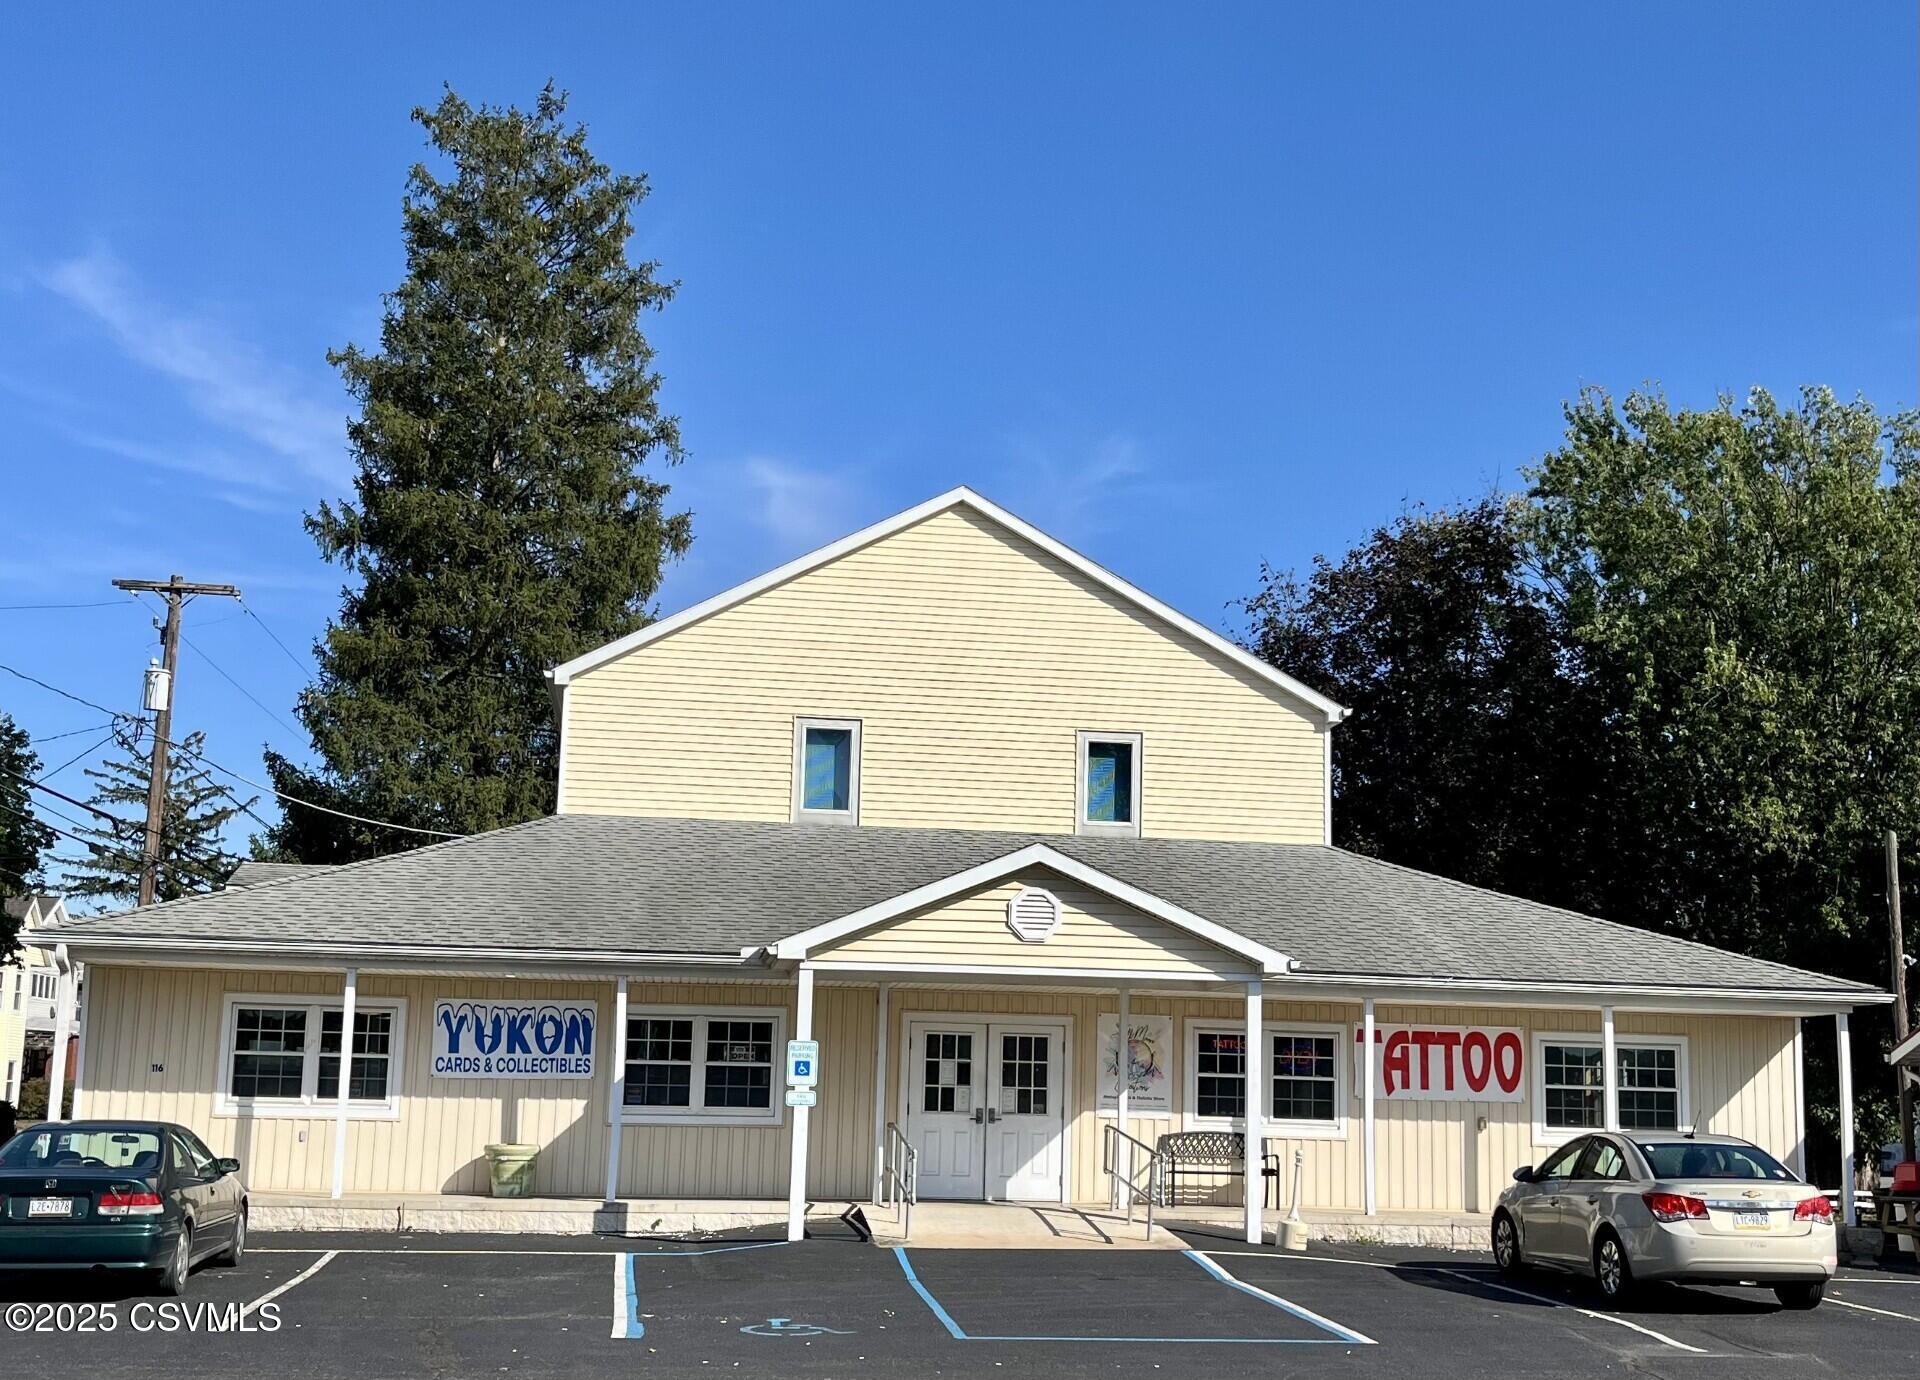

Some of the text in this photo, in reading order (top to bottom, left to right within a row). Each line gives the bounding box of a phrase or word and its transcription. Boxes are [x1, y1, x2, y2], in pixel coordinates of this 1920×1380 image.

[437, 1003, 595, 1056] YUKON
[151, 1063, 164, 1072] 116
[435, 1057, 591, 1073] CARDS & COLLECTIBLES
[1356, 1029, 1522, 1096] ATTOO
